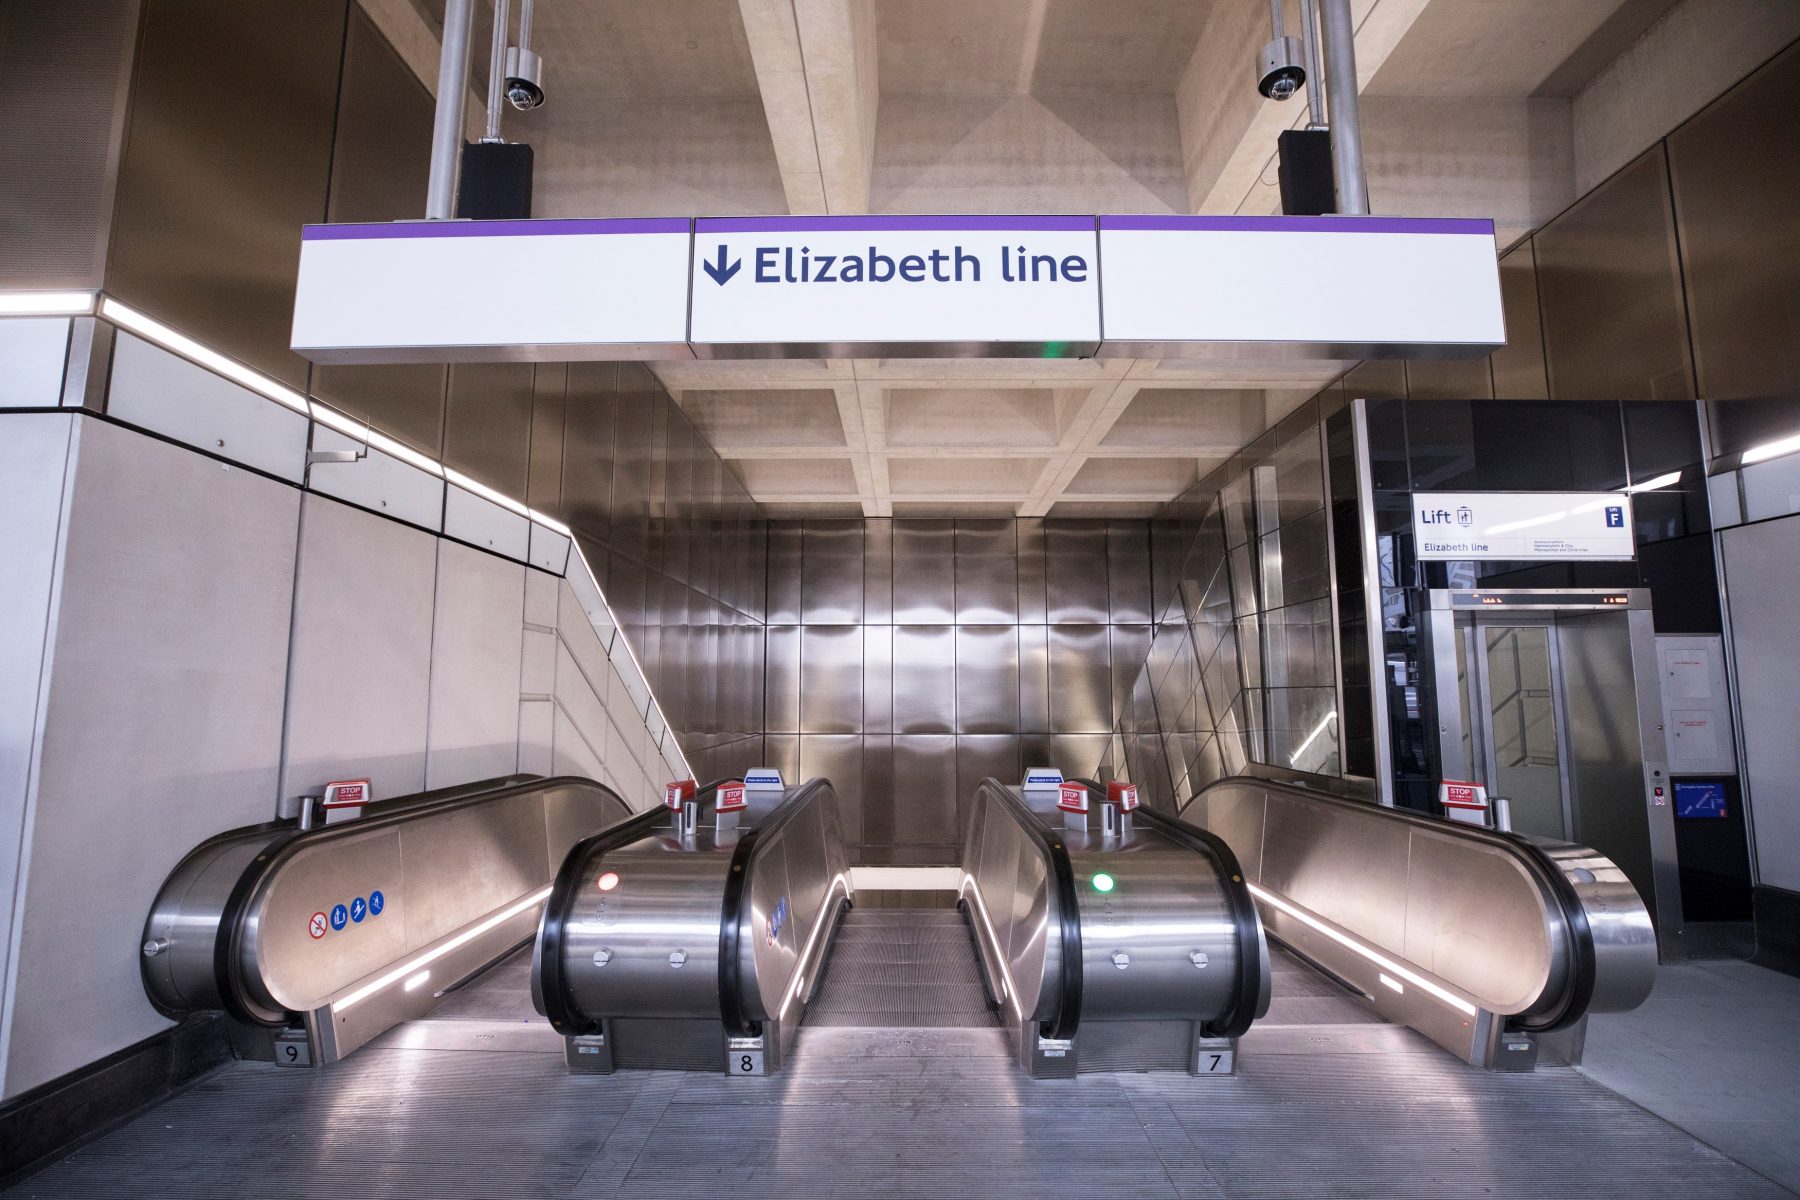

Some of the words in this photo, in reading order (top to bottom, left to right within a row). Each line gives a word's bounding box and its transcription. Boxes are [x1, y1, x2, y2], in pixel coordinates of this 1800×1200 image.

[755, 246, 981, 283] Elizabeth
[1001, 245, 1088, 283] line
[1421, 509, 1452, 524] Lift
[1610, 513, 1619, 526] F
[1424, 543, 1469, 552] Elizabeth
[1471, 543, 1489, 552] line
[341, 786, 361, 794] STOP
[1063, 790, 1078, 798] STOP
[286, 1045, 298, 1062] 9
[740, 1055, 753, 1072] 8
[1209, 1055, 1222, 1072] 7
